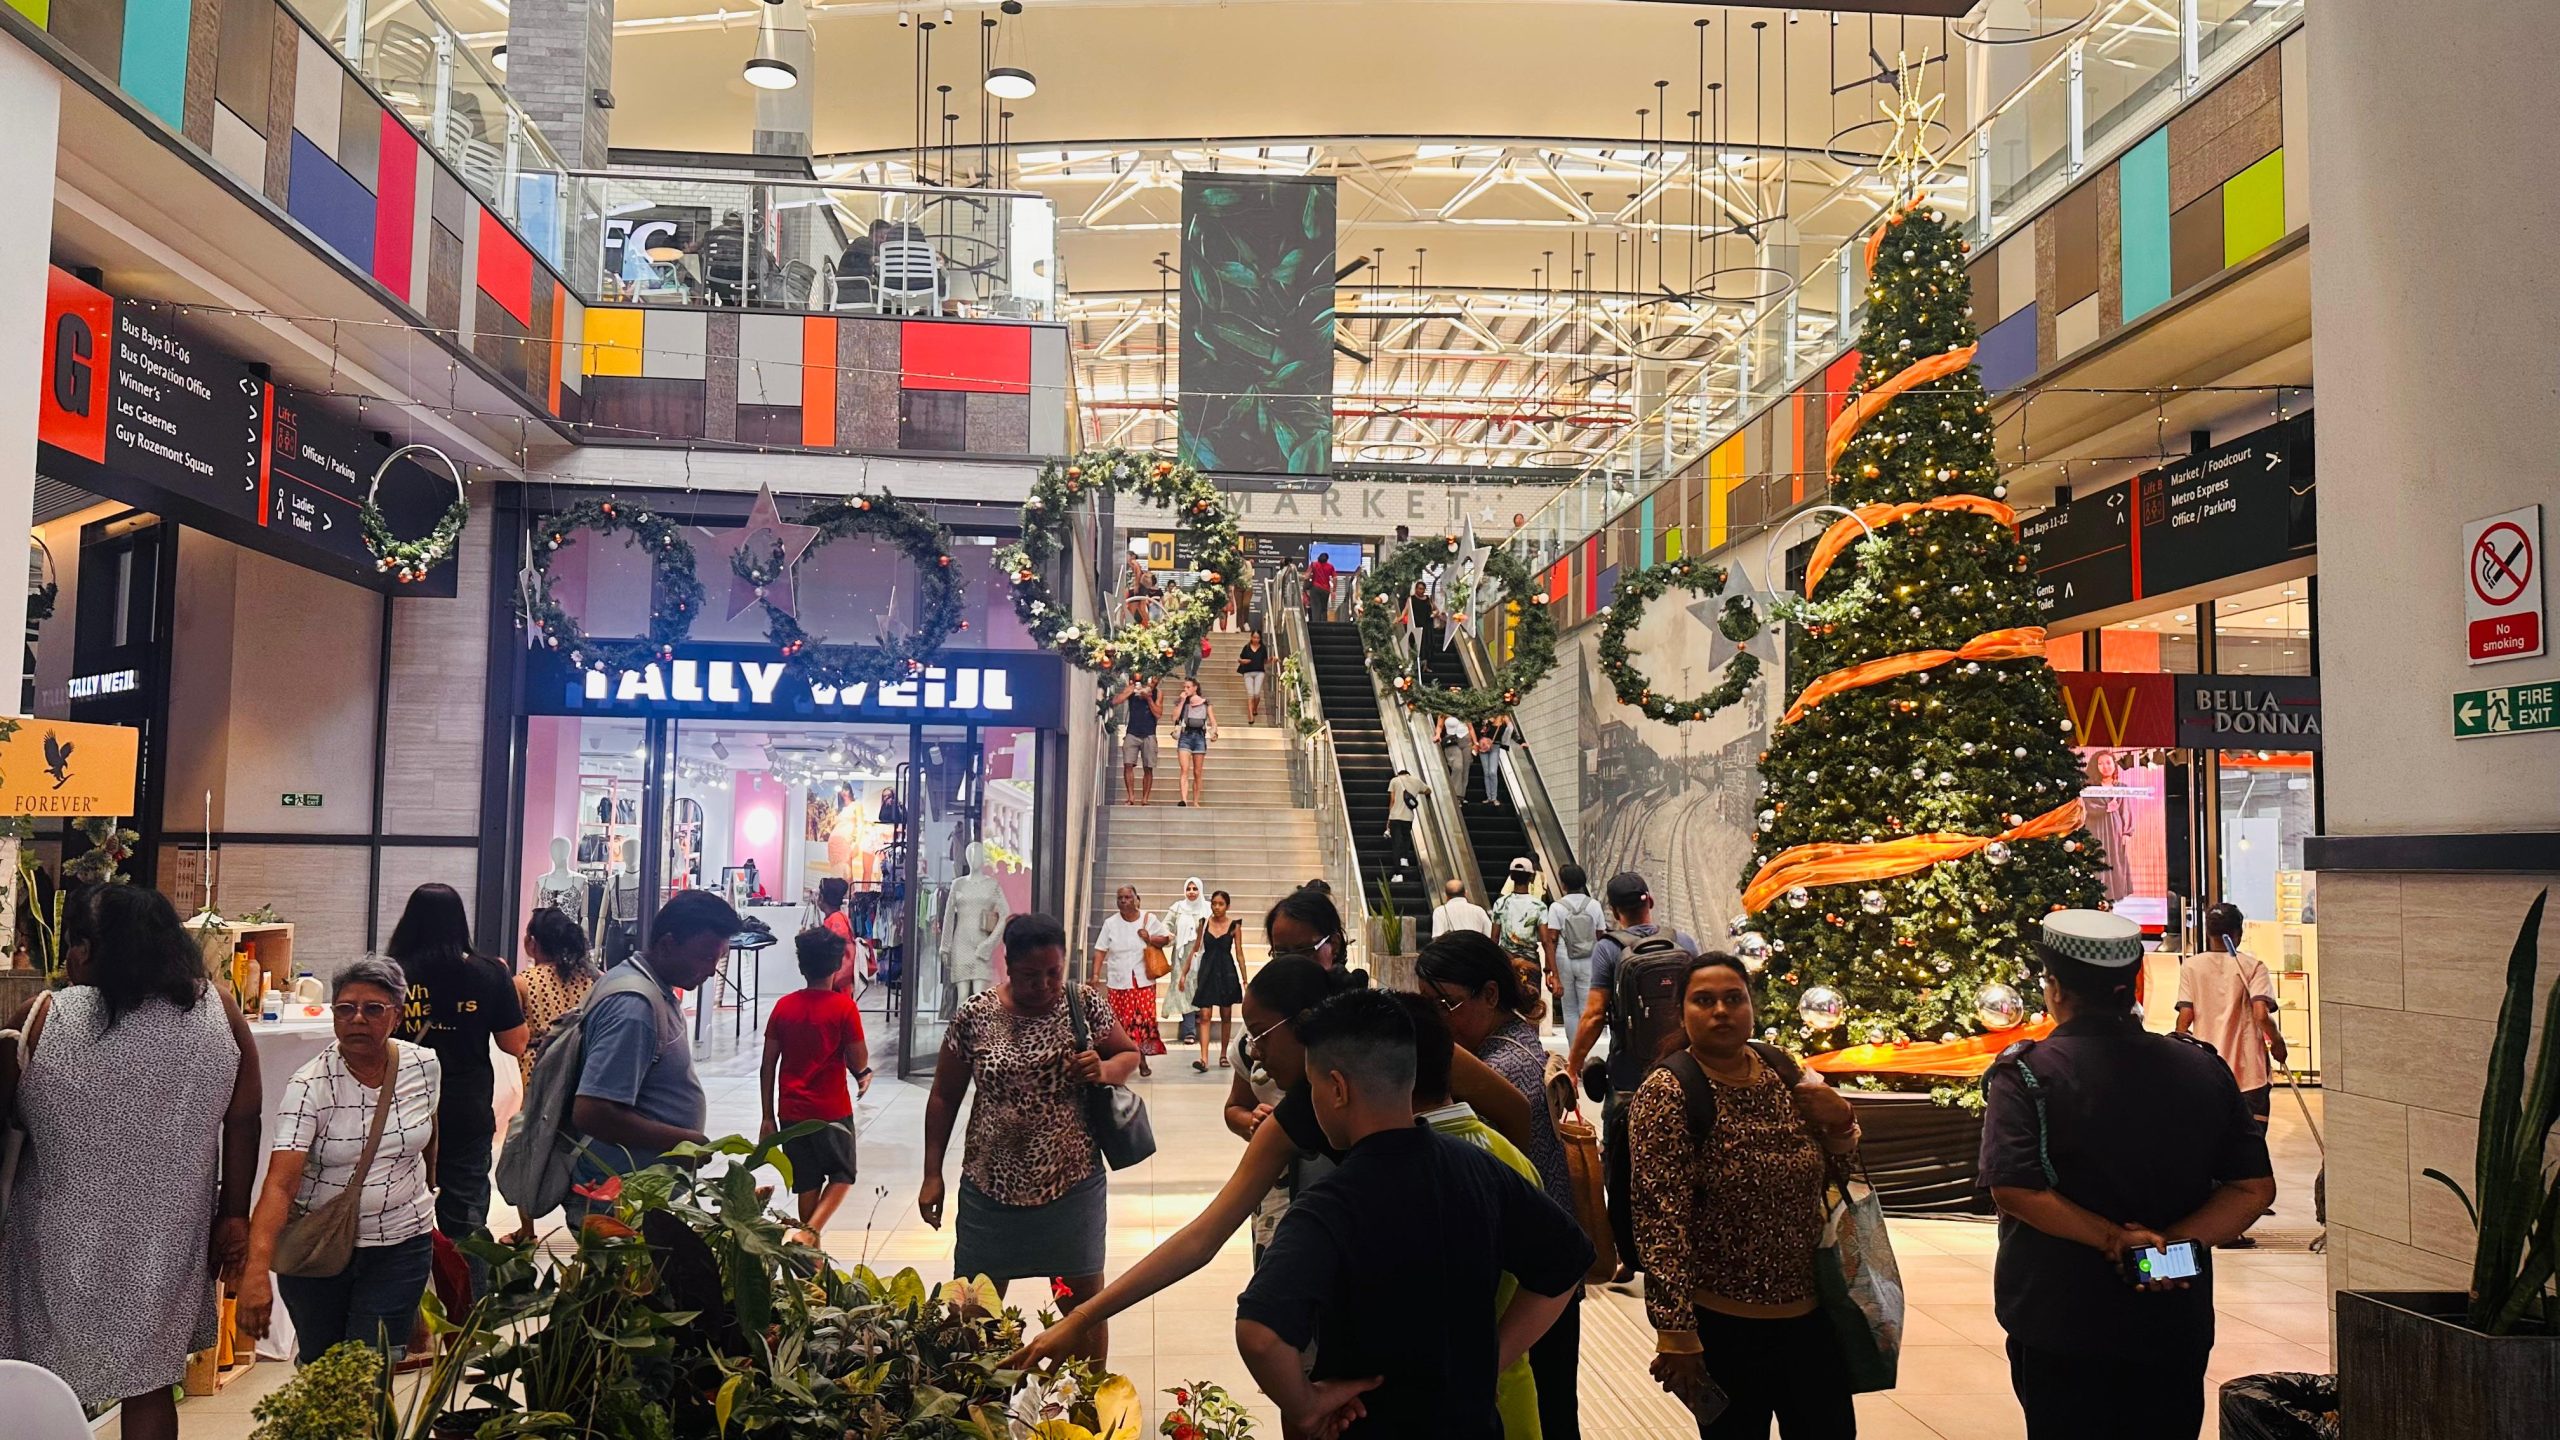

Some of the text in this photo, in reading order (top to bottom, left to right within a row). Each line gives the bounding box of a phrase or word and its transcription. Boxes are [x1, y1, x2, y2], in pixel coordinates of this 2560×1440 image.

[122, 316, 190, 364] Bus Bays 01-06
[54, 312, 93, 417] G
[120, 343, 212, 401] Bus Operation Office
[119, 369, 161, 402] Winner's
[117, 396, 177, 436] Les Casernes
[278, 405, 298, 425] Lift C
[115, 423, 214, 477] Guy Rozemont Square
[302, 444, 325, 466] Offices
[331, 458, 356, 484] Parking
[2170, 467, 2200, 487] Market
[2208, 448, 2252, 473] Foodcourt
[2143, 483, 2156, 496] Lift
[2171, 479, 2229, 507] Metro Express
[292, 494, 315, 515] Ladies
[1224, 488, 1469, 520] MARKET
[2171, 511, 2196, 528] Office
[2203, 498, 2237, 517] Parking
[291, 512, 312, 533] Toilet
[2023, 513, 2069, 538] Bus Bays 11-22
[1150, 540, 1171, 561] 01
[2036, 584, 2055, 597] Gents
[2037, 598, 2054, 611] Toilet
[2496, 624, 2511, 635] No
[2482, 637, 2525, 652] smoking
[68, 675, 99, 698] TALLY
[2518, 687, 2553, 706] FIRE
[2196, 689, 2280, 711] BELLA
[2215, 711, 2321, 734] DONNA
[2519, 707, 2552, 725] EXIT
